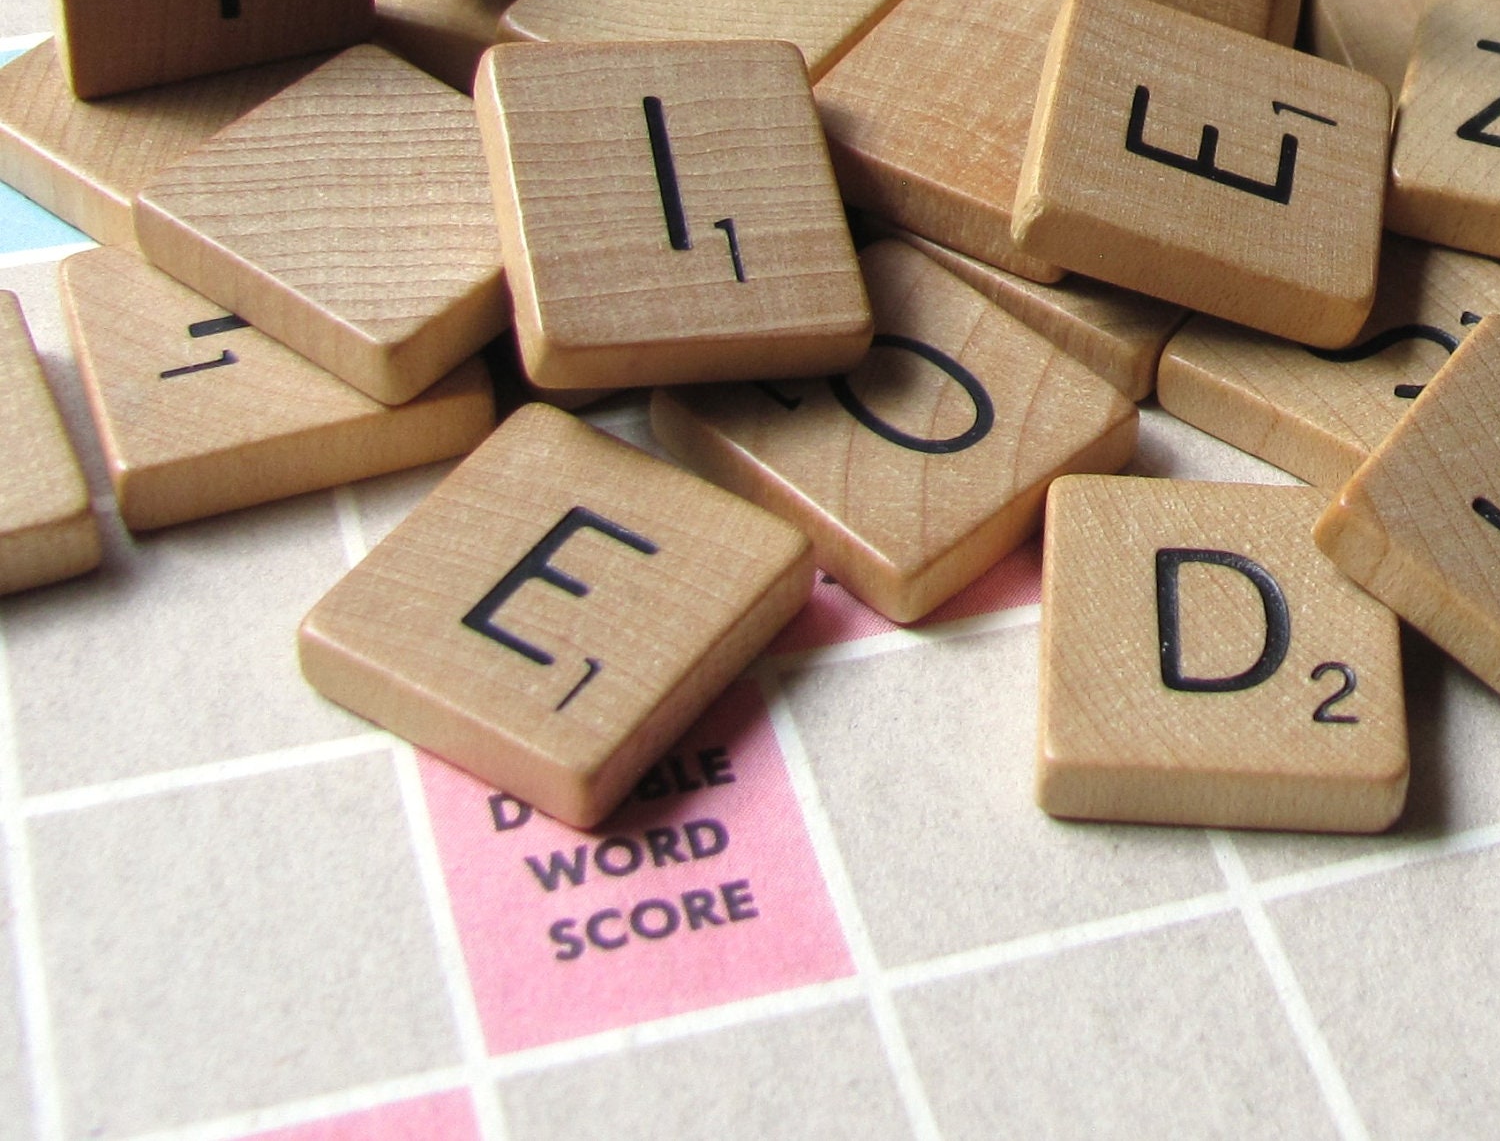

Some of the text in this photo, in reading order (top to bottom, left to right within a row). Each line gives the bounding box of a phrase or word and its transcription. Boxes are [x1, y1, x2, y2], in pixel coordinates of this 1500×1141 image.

[1125, 85, 1300, 206] E
[461, 505, 661, 666] E
[1155, 547, 1292, 694] D
[524, 817, 730, 893] WORD
[547, 878, 760, 962] SCORE
